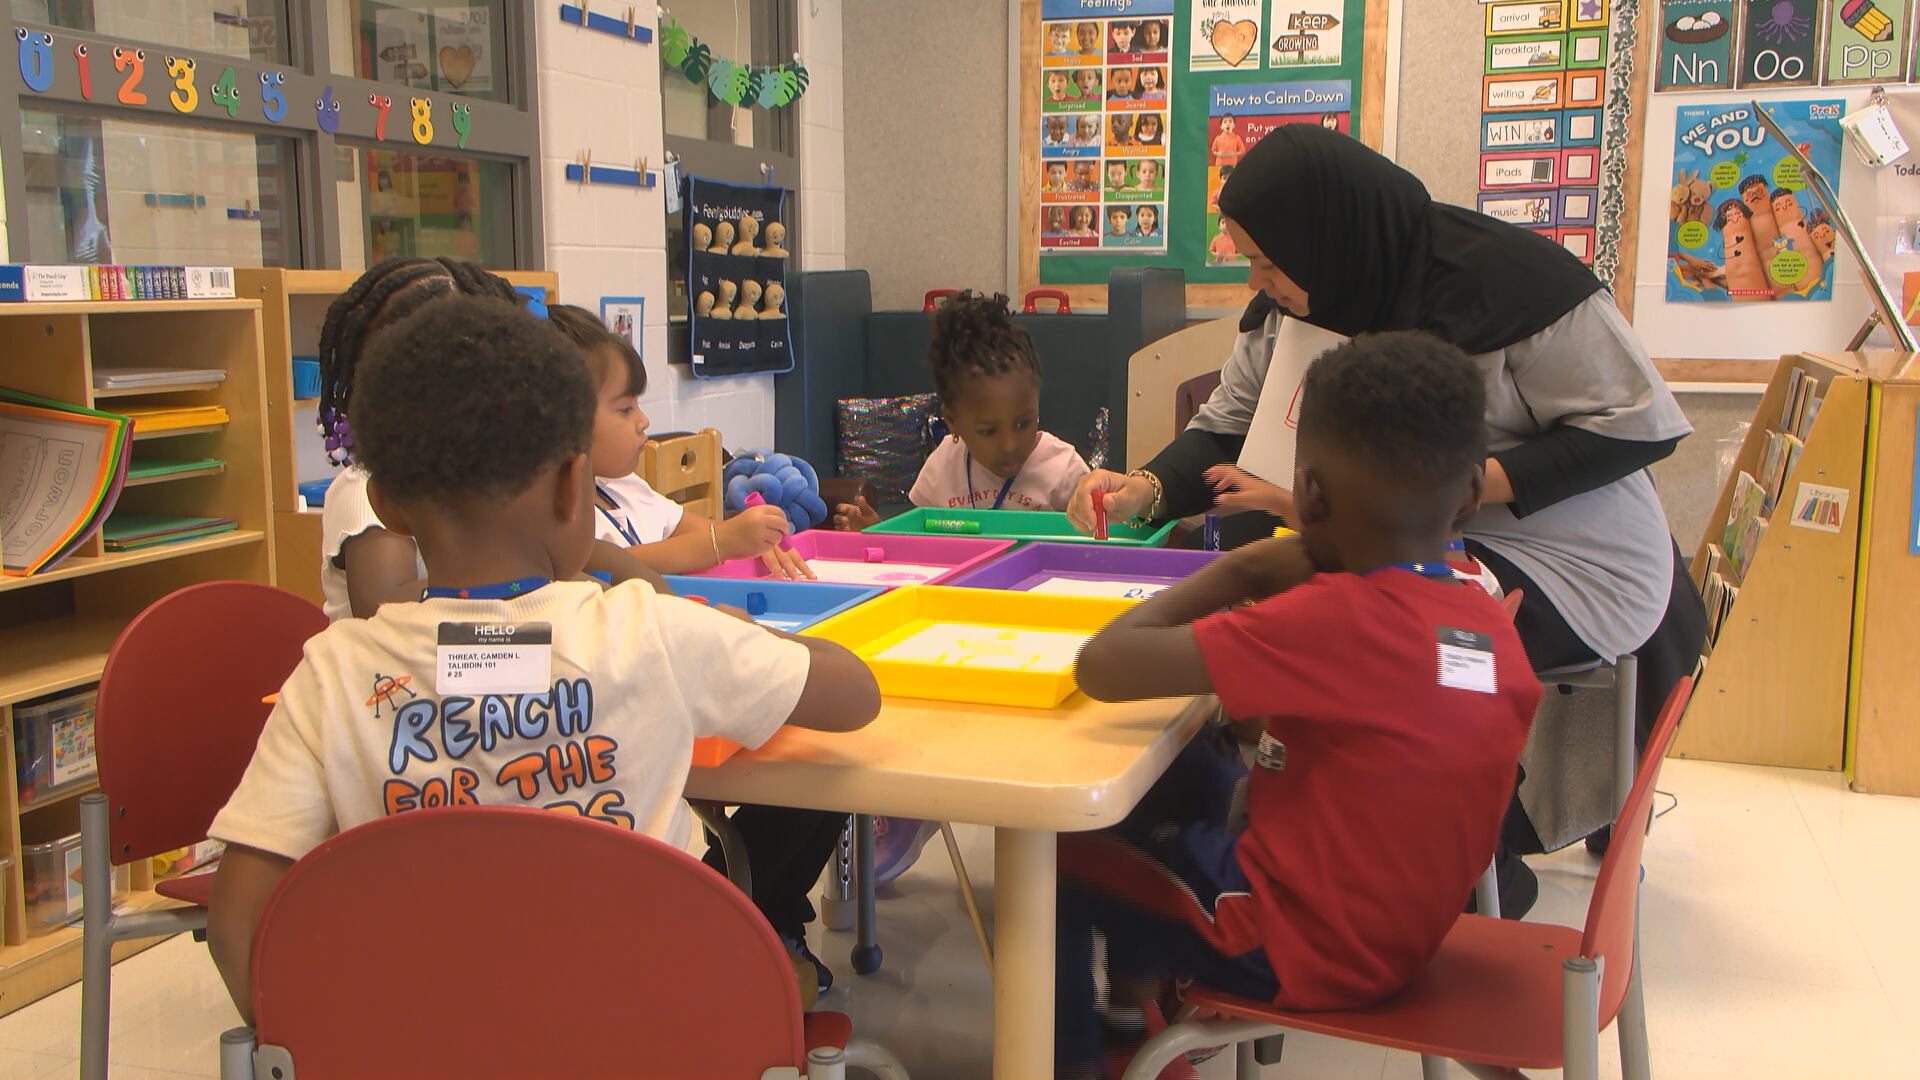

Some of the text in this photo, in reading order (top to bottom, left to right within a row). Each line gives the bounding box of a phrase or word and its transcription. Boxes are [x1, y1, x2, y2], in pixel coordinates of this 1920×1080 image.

[1499, 13, 1530, 23] arrival
[1278, 37, 1318, 51] GROWING
[1494, 44, 1541, 56] breakfast
[1131, 54, 1143, 62] Sad
[1841, 44, 1891, 79] Pp
[1672, 51, 1719, 85] Nn
[1753, 48, 1804, 81] Oo
[16, 27, 472, 149] 0 1 2 3 4 5 6 7 8 9
[1216, 88, 1344, 107] How to Calm Down
[1492, 89, 1525, 100] writing
[1126, 101, 1147, 109] Scared
[1247, 123, 1263, 132] Put
[1489, 124, 1521, 142] WIN
[1681, 109, 1749, 145] ME AND
[1693, 126, 1766, 156] YOU
[1062, 148, 1081, 156] Angry
[1495, 167, 1522, 177] iPads
[1490, 207, 1518, 217] music
[1809, 488, 1837, 500] Library
[474, 625, 515, 636] HELLO
[448, 653, 479, 661] THREAT,
[480, 652, 514, 660] CAMDEN
[389, 677, 594, 775] REACH
[495, 735, 619, 801] THE
